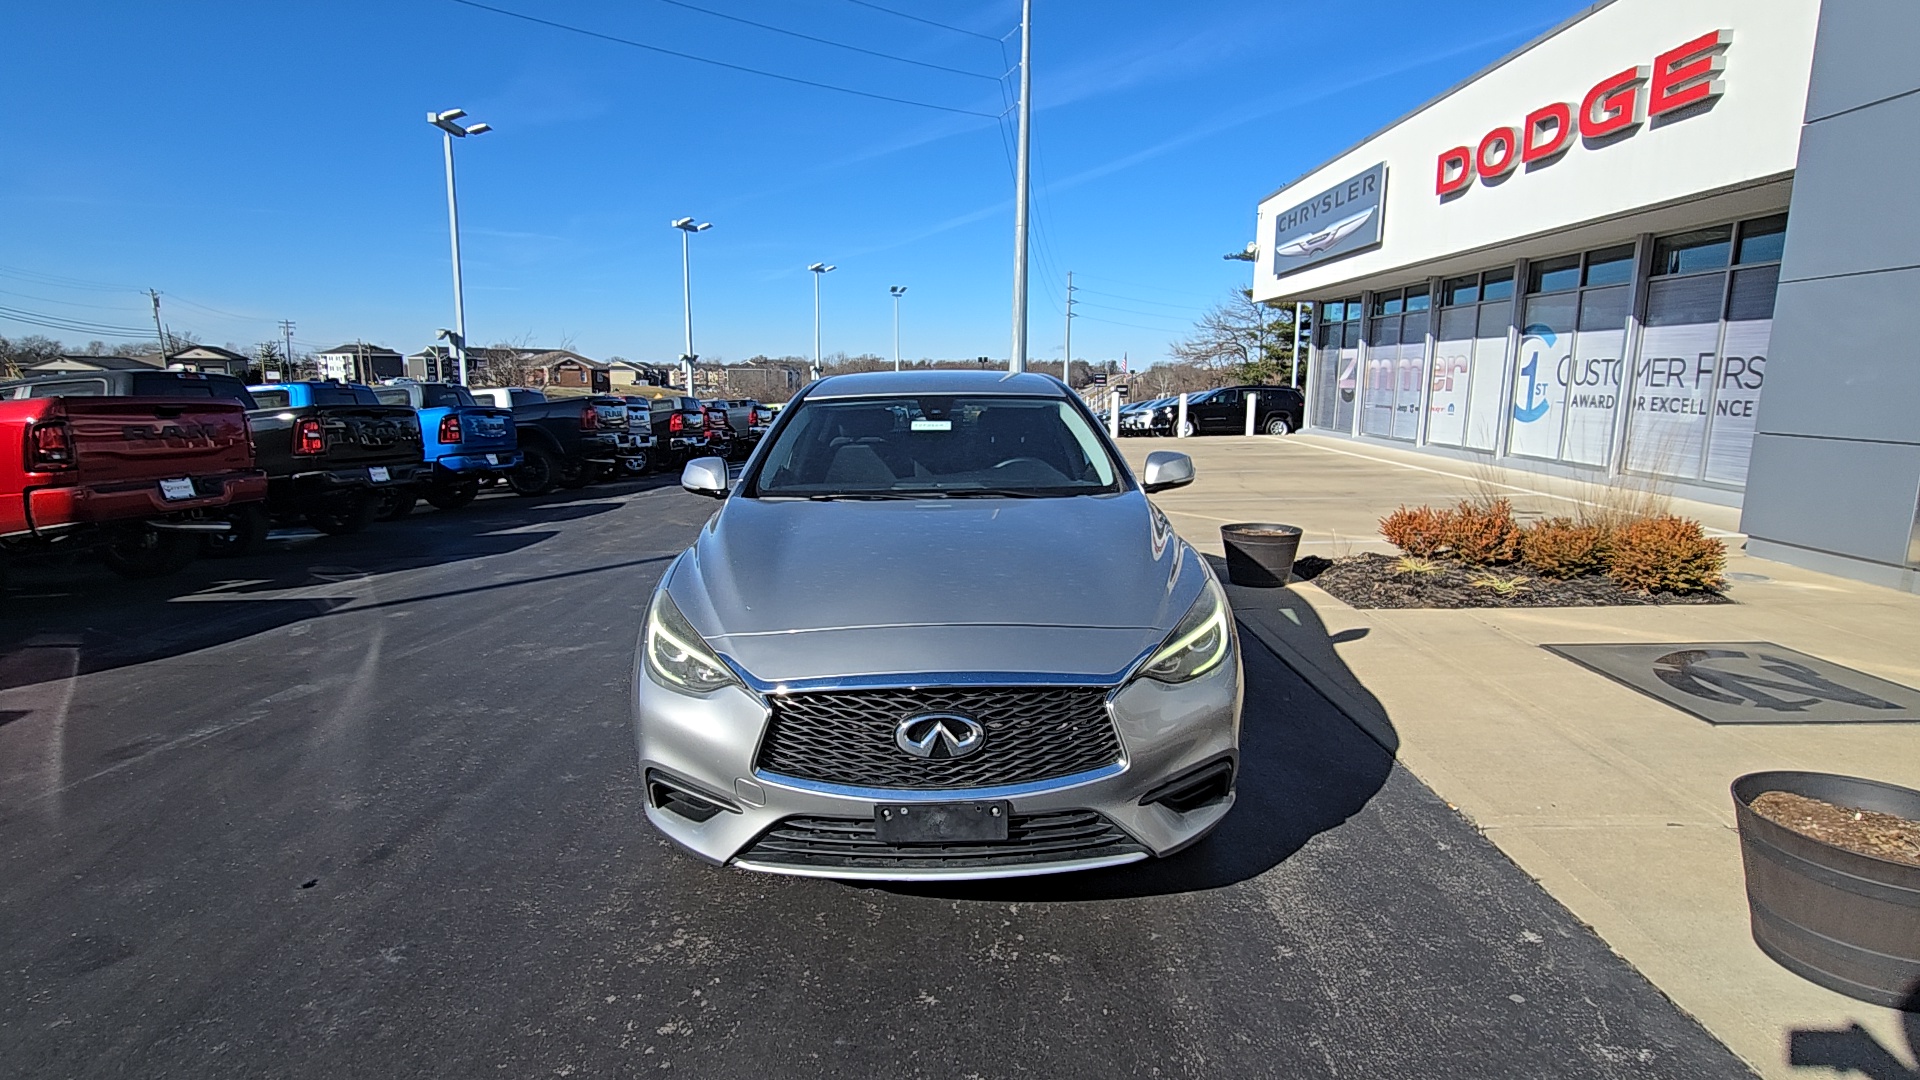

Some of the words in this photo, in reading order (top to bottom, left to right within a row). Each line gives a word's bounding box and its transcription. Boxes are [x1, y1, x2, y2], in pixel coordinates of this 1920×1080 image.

[1436, 29, 1733, 196] DODGE
[1277, 173, 1376, 233] CHRYSLER
[1339, 349, 1468, 392] Zmmer
[1695, 352, 1767, 389] FIRS
[1571, 394, 1615, 409] AWARD
[1650, 396, 1754, 417] EXCELLNCE
[122, 423, 217, 441] RAM
